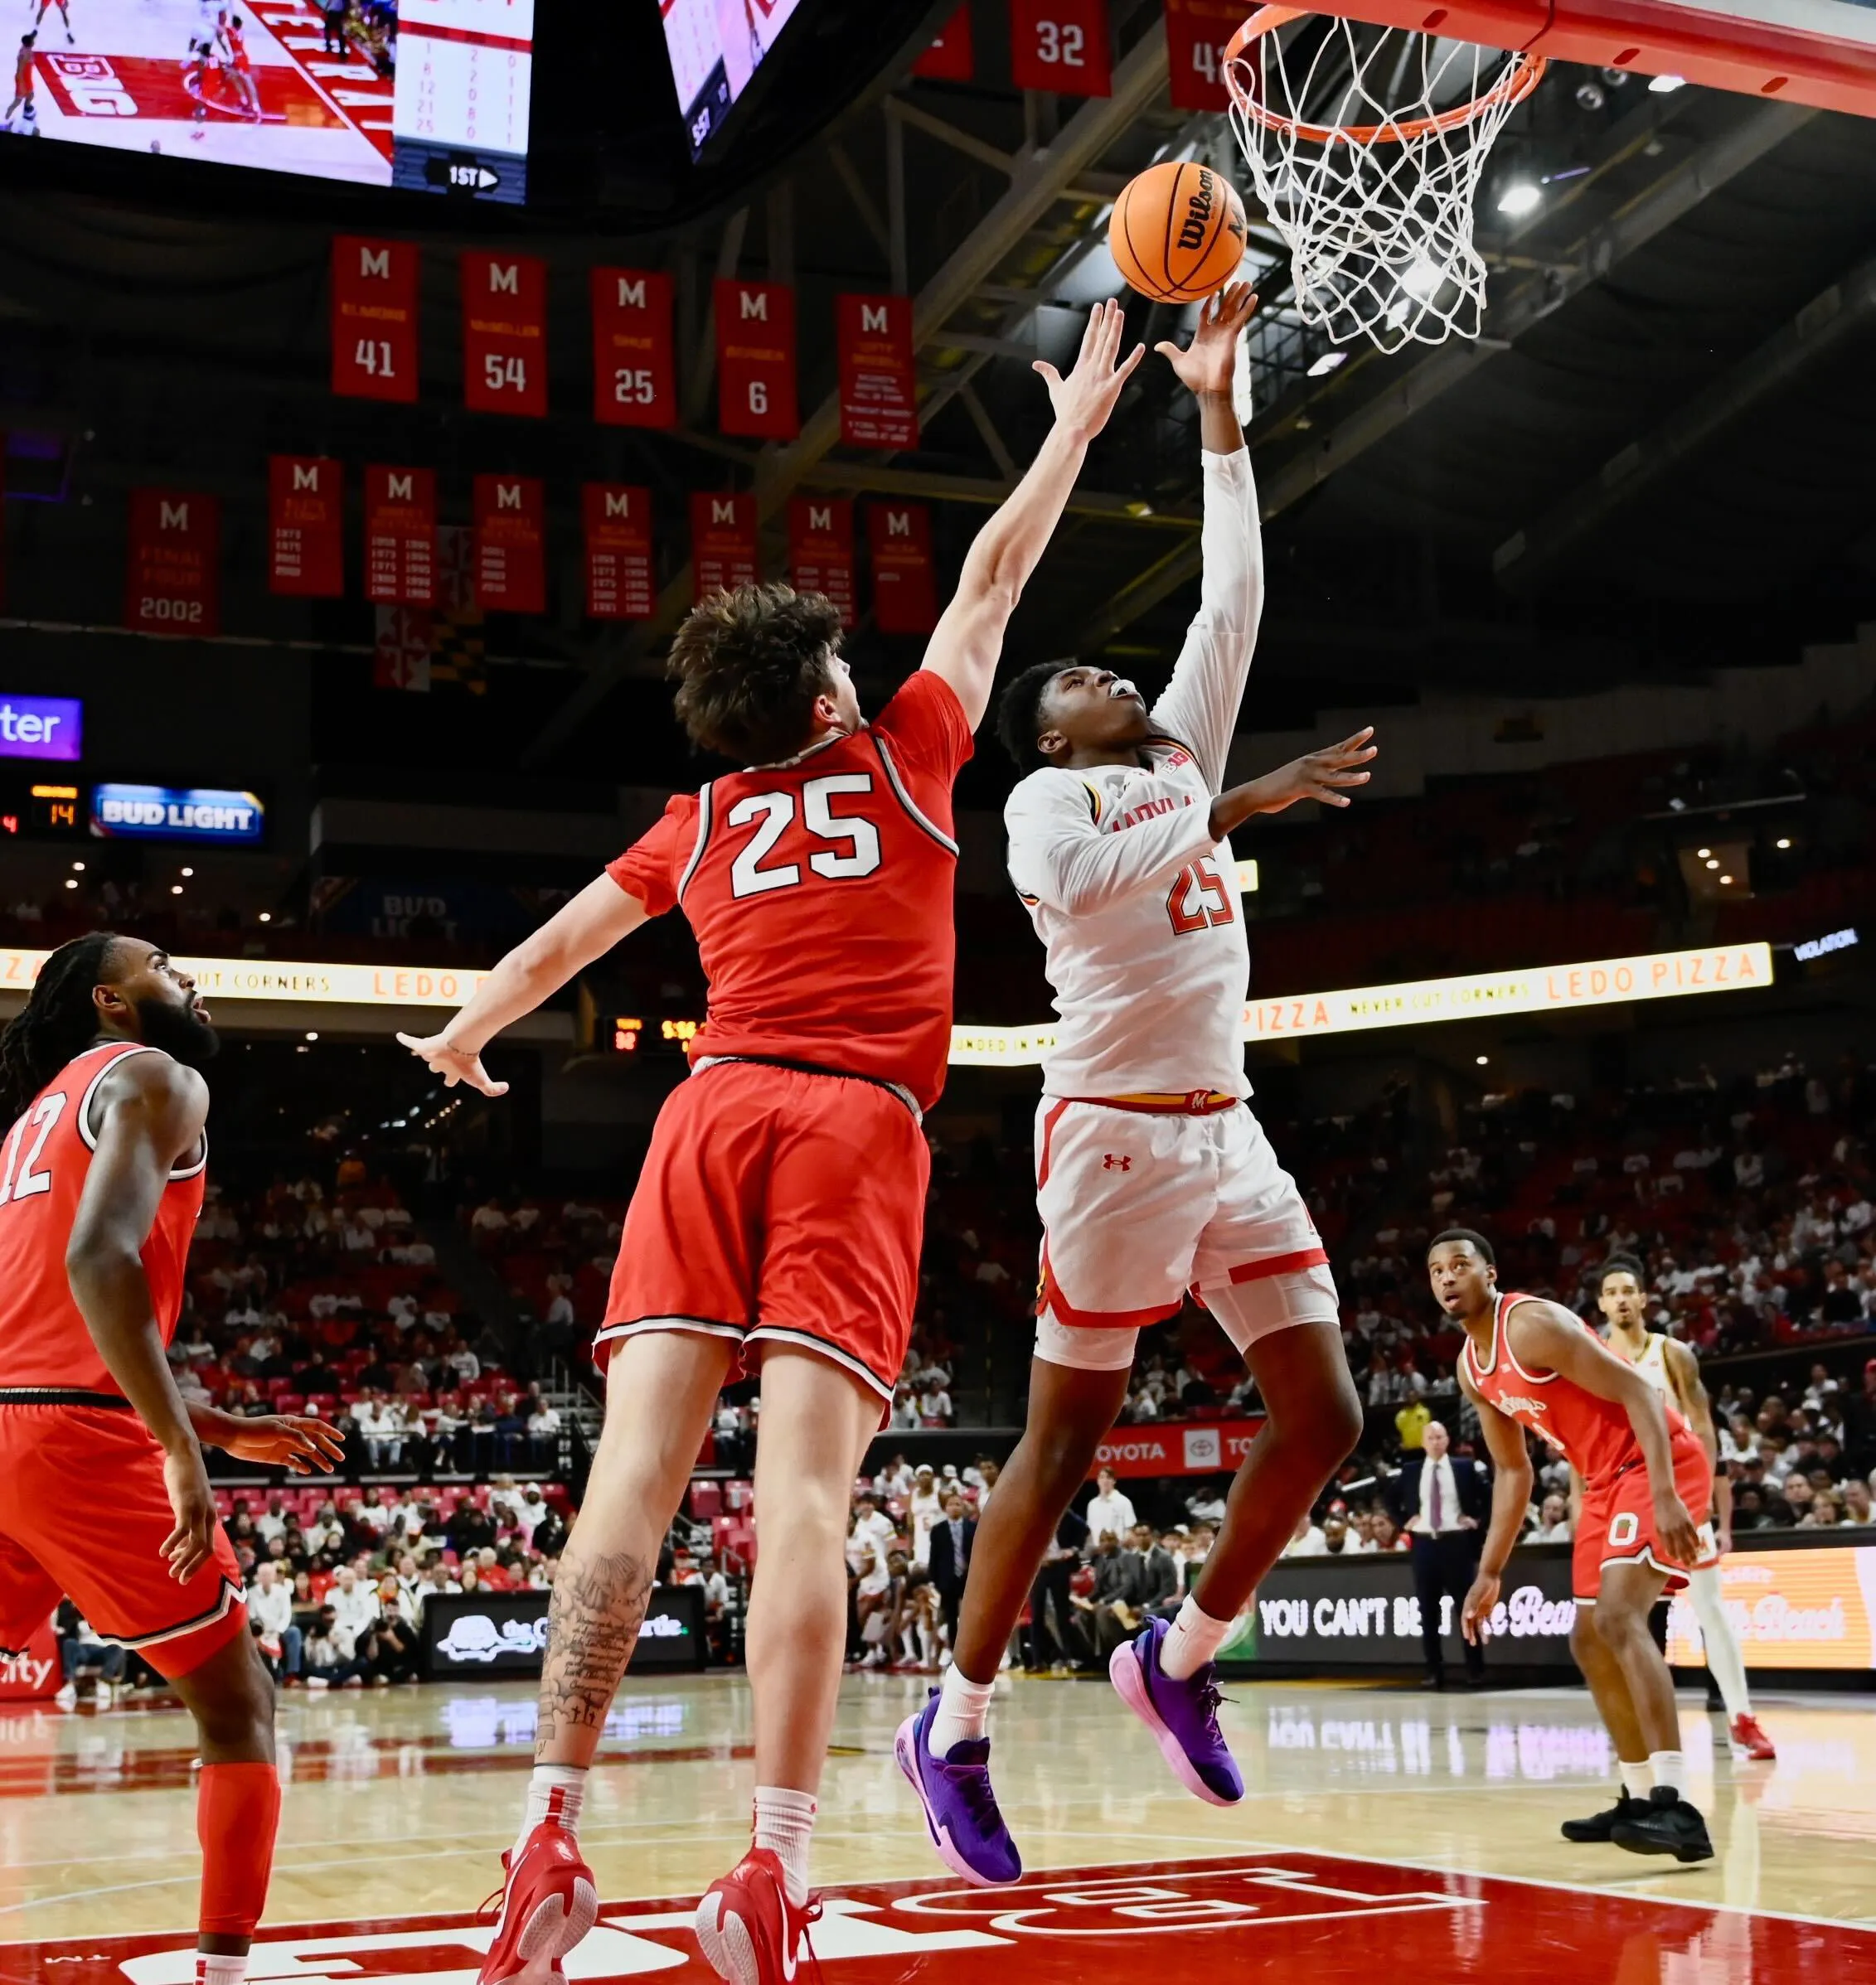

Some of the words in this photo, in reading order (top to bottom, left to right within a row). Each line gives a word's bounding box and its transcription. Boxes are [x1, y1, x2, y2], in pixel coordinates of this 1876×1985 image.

[1036, 21, 1084, 66] 32
[449, 166, 479, 187] 1ST
[1177, 170, 1214, 250] Wilson
[361, 247, 390, 278] M
[490, 263, 518, 294] M
[618, 278, 646, 308] M
[740, 291, 768, 322] M
[860, 303, 888, 334] M
[355, 339, 395, 377] 41
[485, 354, 526, 392] 54
[615, 369, 655, 404] 25
[749, 381, 768, 414] 6
[293, 463, 318, 492] M
[387, 472, 413, 501] M
[497, 483, 521, 511] M
[604, 491, 629, 517] M
[711, 499, 735, 525] M
[159, 501, 189, 532] M
[808, 506, 831, 530] M
[887, 511, 909, 536] M
[139, 597, 204, 623] 2002
[0, 704, 61, 743] ter
[51, 804, 74, 825] 14
[102, 801, 167, 825] BUD
[168, 805, 254, 830] LIGHT
[727, 773, 882, 900] 25
[383, 895, 447, 917] BUD
[1166, 854, 1235, 936] 25
[197, 972, 221, 986] UT
[235, 974, 331, 992] CORNERS
[374, 972, 458, 998] LEDO
[1451, 982, 1529, 1005] CORNERS
[1547, 967, 1633, 1000] LEDO
[1652, 953, 1755, 988] PIZZA
[956, 1039, 1006, 1052] UNDED
[0, 1092, 67, 1208] 12
[1095, 1442, 1166, 1462] OYOTA
[1259, 1599, 1308, 1636] YOU
[1314, 1597, 1388, 1636] CAN'T
